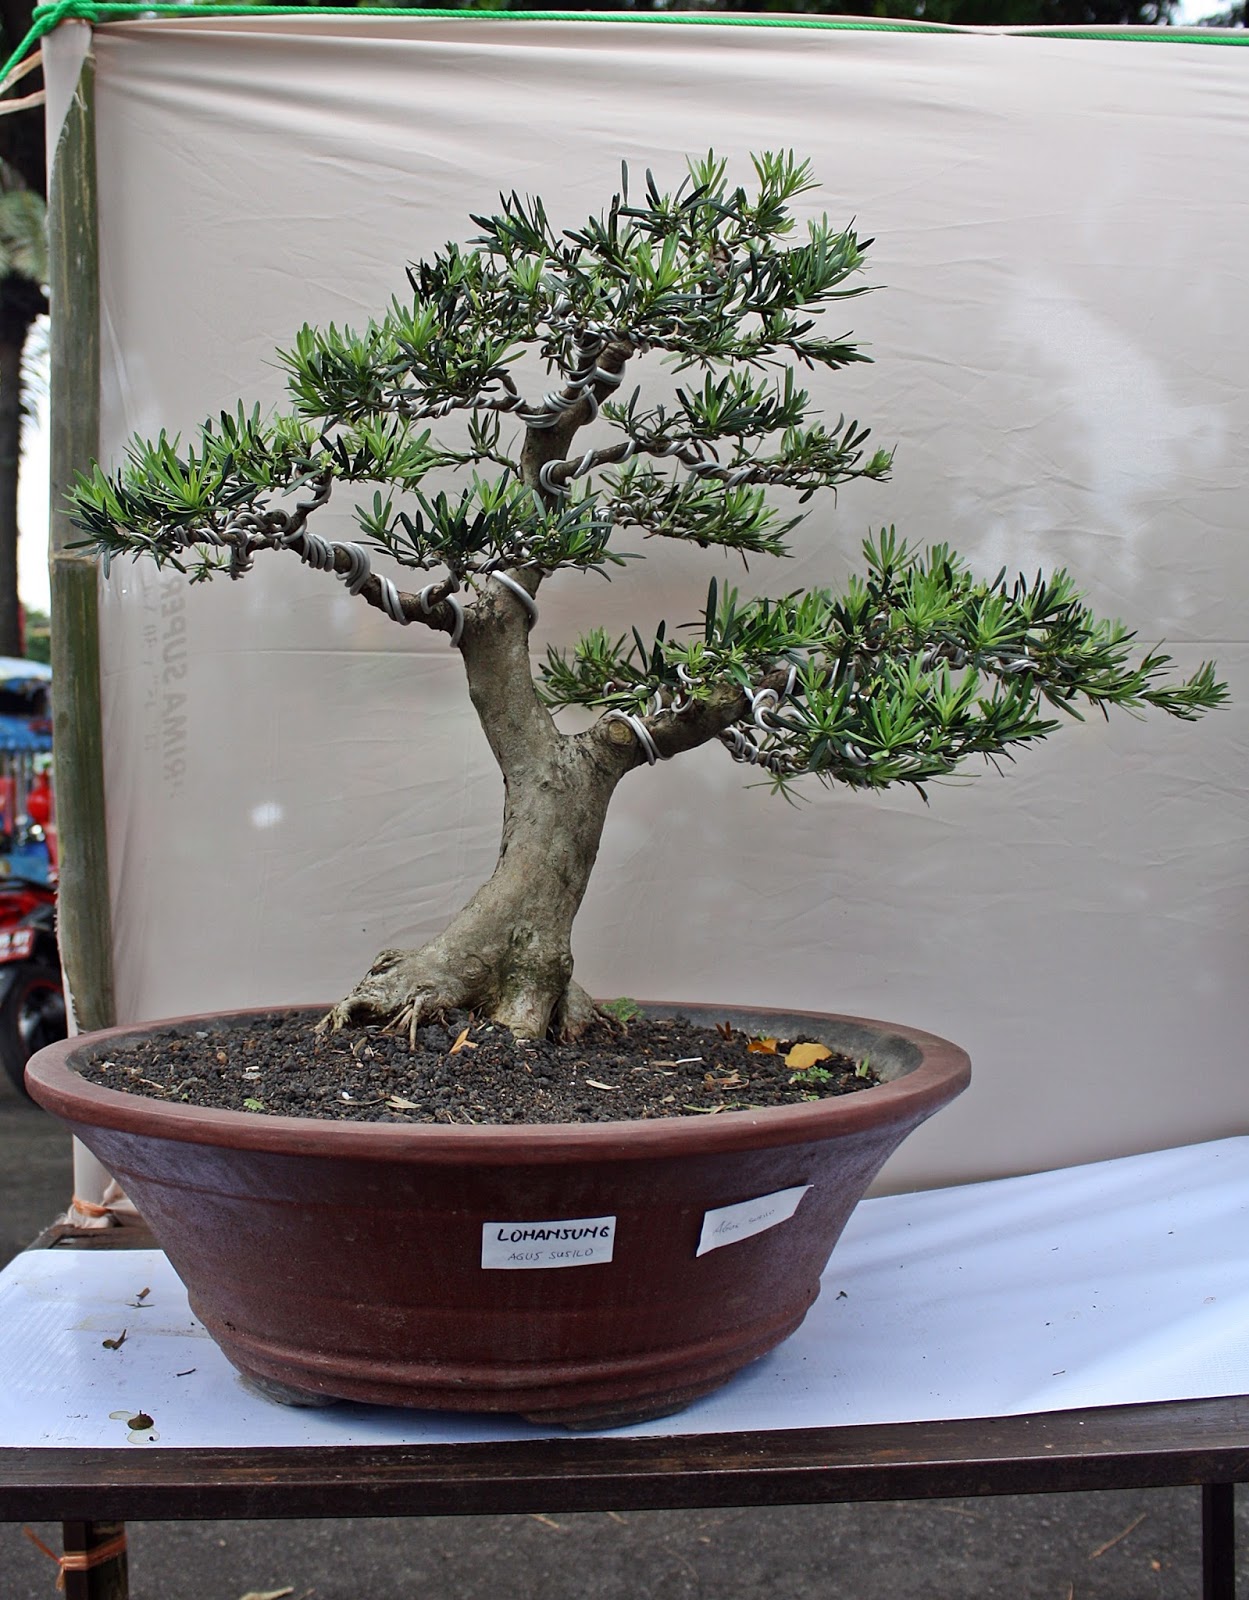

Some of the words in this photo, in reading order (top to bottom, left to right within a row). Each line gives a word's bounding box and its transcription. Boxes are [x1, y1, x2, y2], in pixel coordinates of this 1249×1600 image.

[497, 1226, 610, 1243] LOHANSUNG
[508, 1251, 543, 1261] AGUS
[548, 1248, 594, 1260] SUSILO
